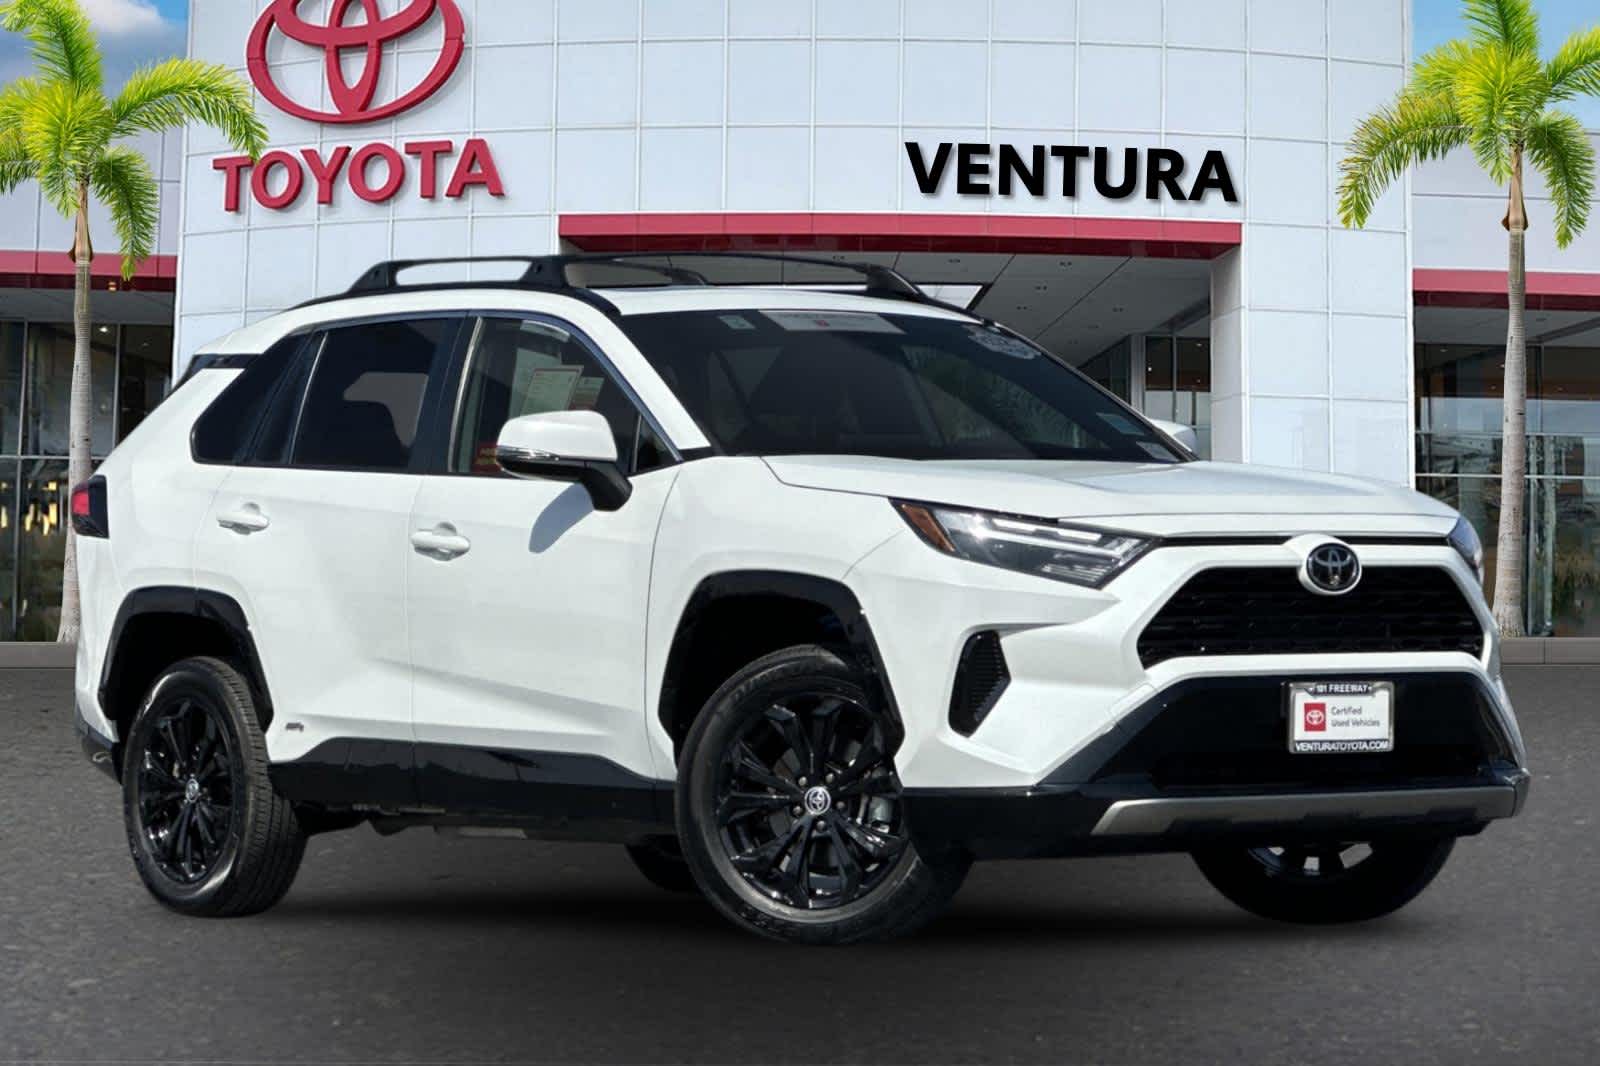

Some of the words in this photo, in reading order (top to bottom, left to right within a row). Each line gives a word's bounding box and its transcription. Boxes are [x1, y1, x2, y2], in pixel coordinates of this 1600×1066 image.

[212, 138, 505, 213] TOYOTA
[904, 141, 1239, 203] VENTURA
[1328, 683, 1368, 693] FREEWAY
[1331, 706, 1362, 716] Certified
[1331, 719, 1350, 727] Used
[1351, 718, 1380, 727] Vehicles
[1295, 740, 1388, 751] VENTURATOYOTA.COM
